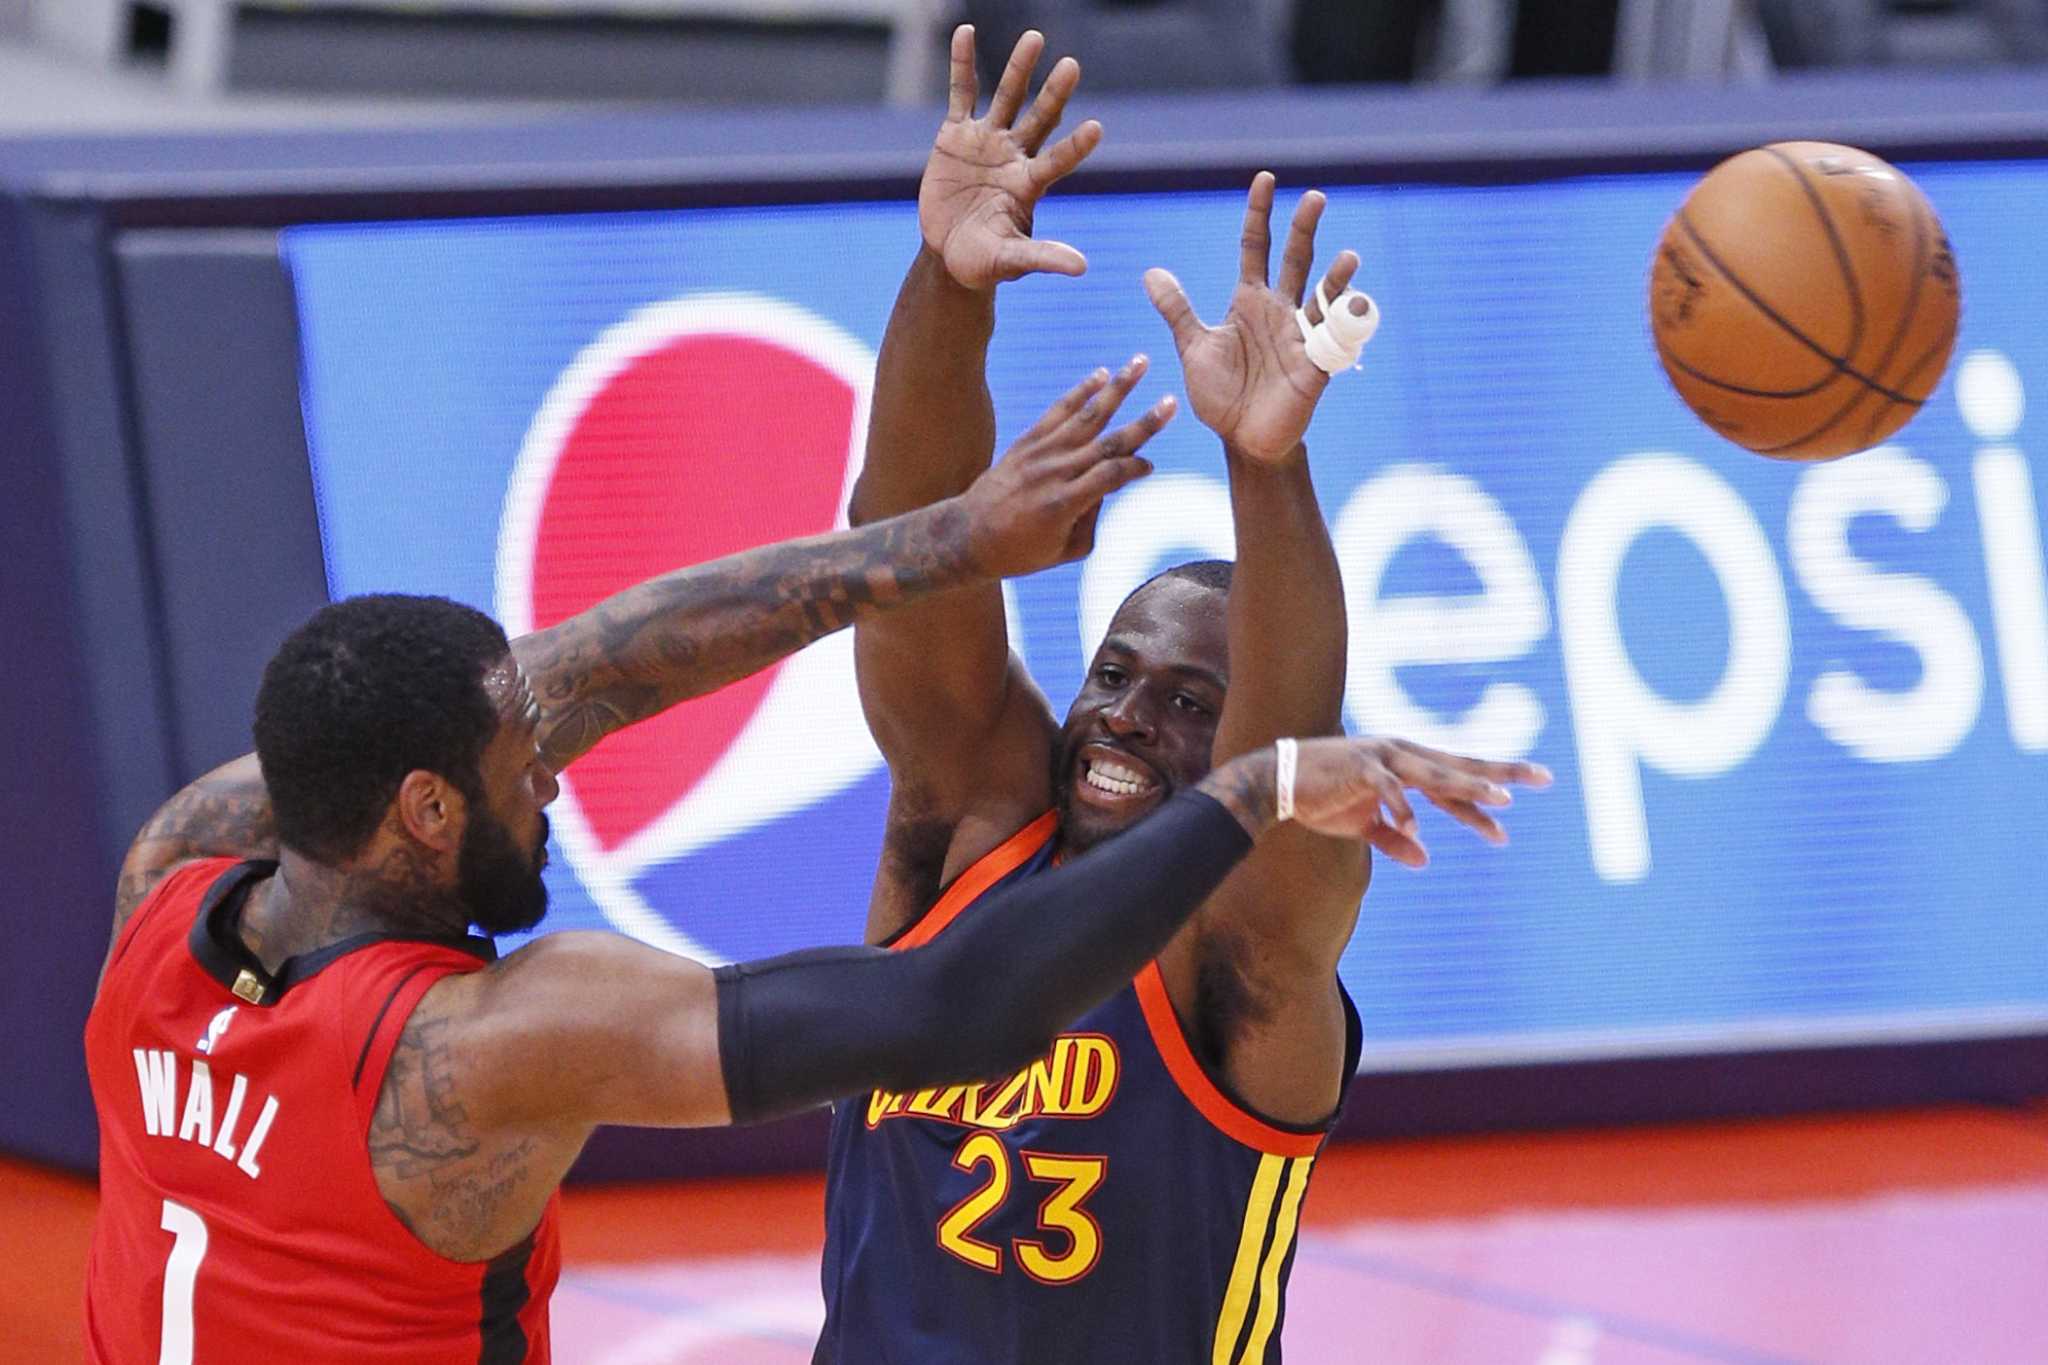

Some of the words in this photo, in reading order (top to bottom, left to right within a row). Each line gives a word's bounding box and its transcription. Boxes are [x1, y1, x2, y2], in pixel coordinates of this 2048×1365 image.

[1080, 349, 2048, 883] epsi
[132, 1048, 280, 1180] WALL
[159, 1199, 208, 1365] 1
[937, 1129, 1108, 1285] 23
